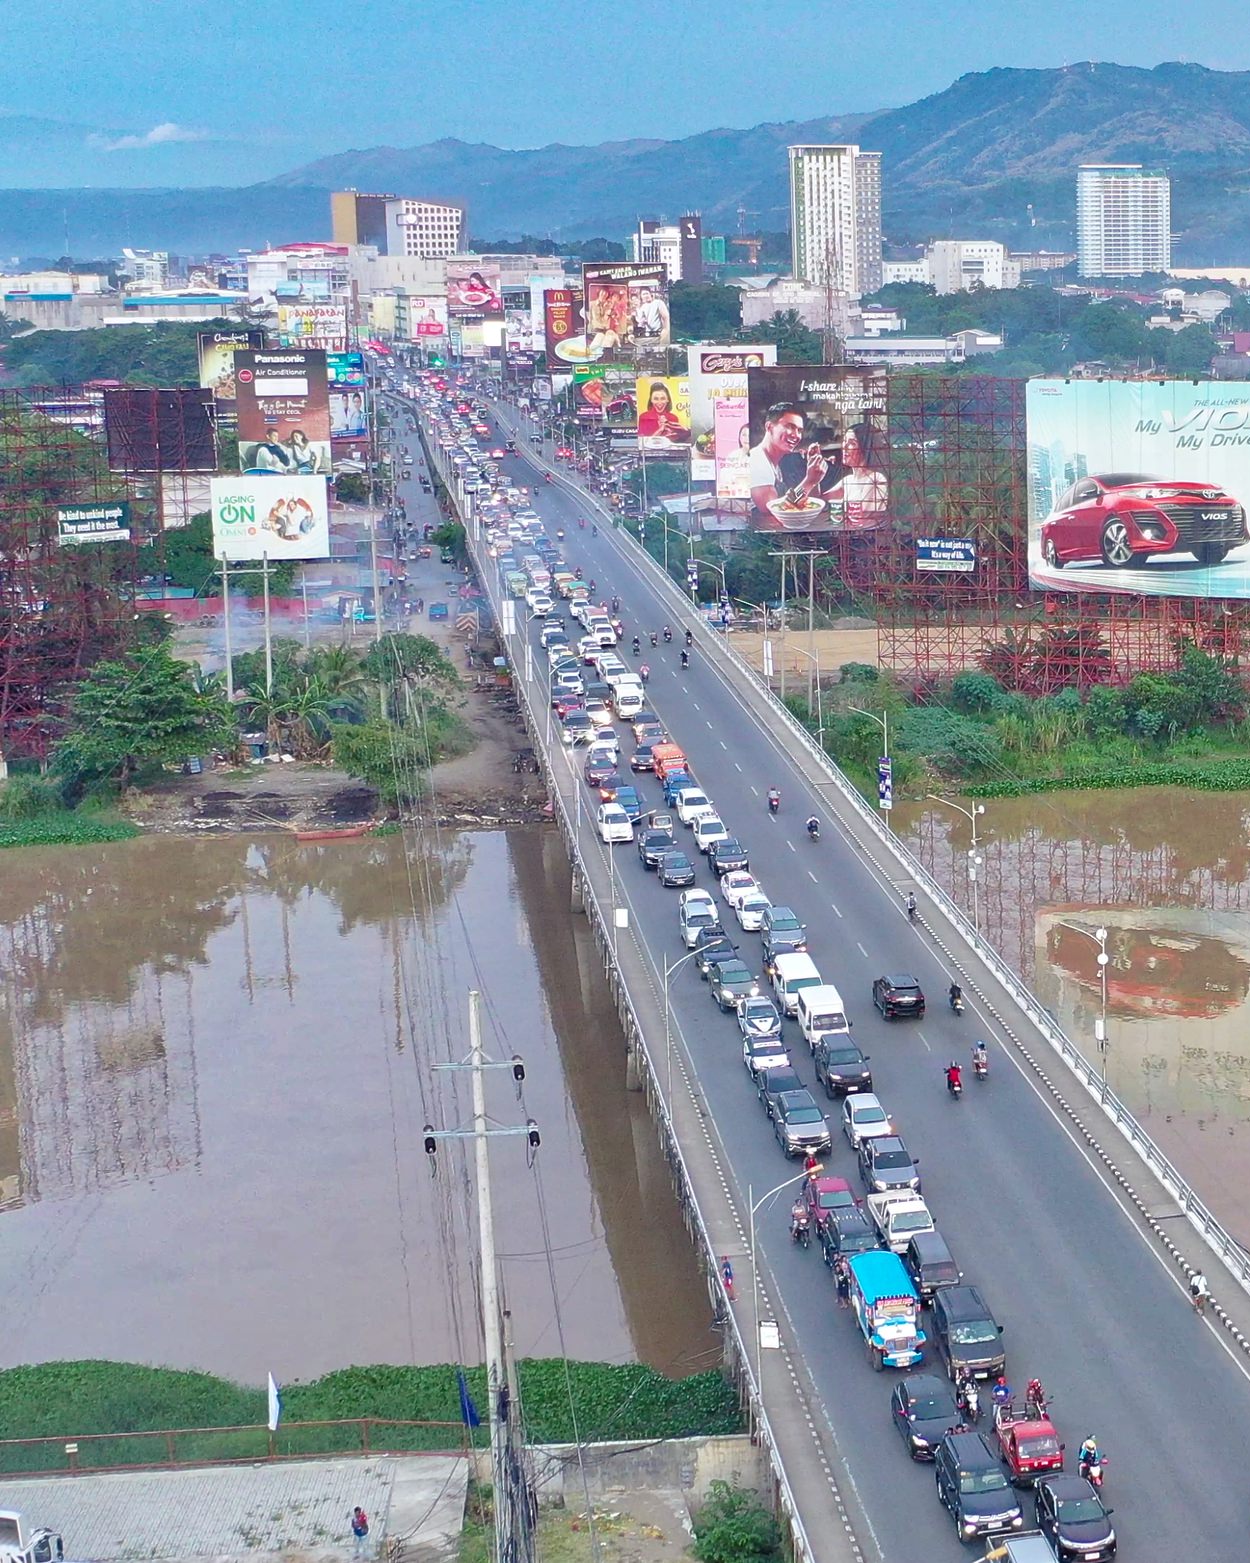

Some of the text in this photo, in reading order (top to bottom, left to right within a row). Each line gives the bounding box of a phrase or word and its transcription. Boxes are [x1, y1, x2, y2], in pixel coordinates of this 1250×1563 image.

[254, 354, 306, 364] Panasonic
[702, 354, 743, 372] Gerry's
[267, 368, 307, 376] Conditioner
[800, 379, 837, 392] I-share
[834, 400, 856, 414] nga
[1194, 398, 1250, 407] THE ALL-NEW
[1135, 420, 1162, 435] My
[1176, 434, 1203, 450] My
[218, 495, 256, 505] LAGING
[66, 510, 79, 520] kind
[79, 510, 86, 519] to
[86, 508, 105, 519] unkind
[219, 504, 256, 524] ON
[1201, 512, 1228, 521] VIOS
[63, 522, 77, 534] They
[78, 521, 91, 532] need
[96, 521, 105, 530] the
[220, 528, 247, 537] OMNI
